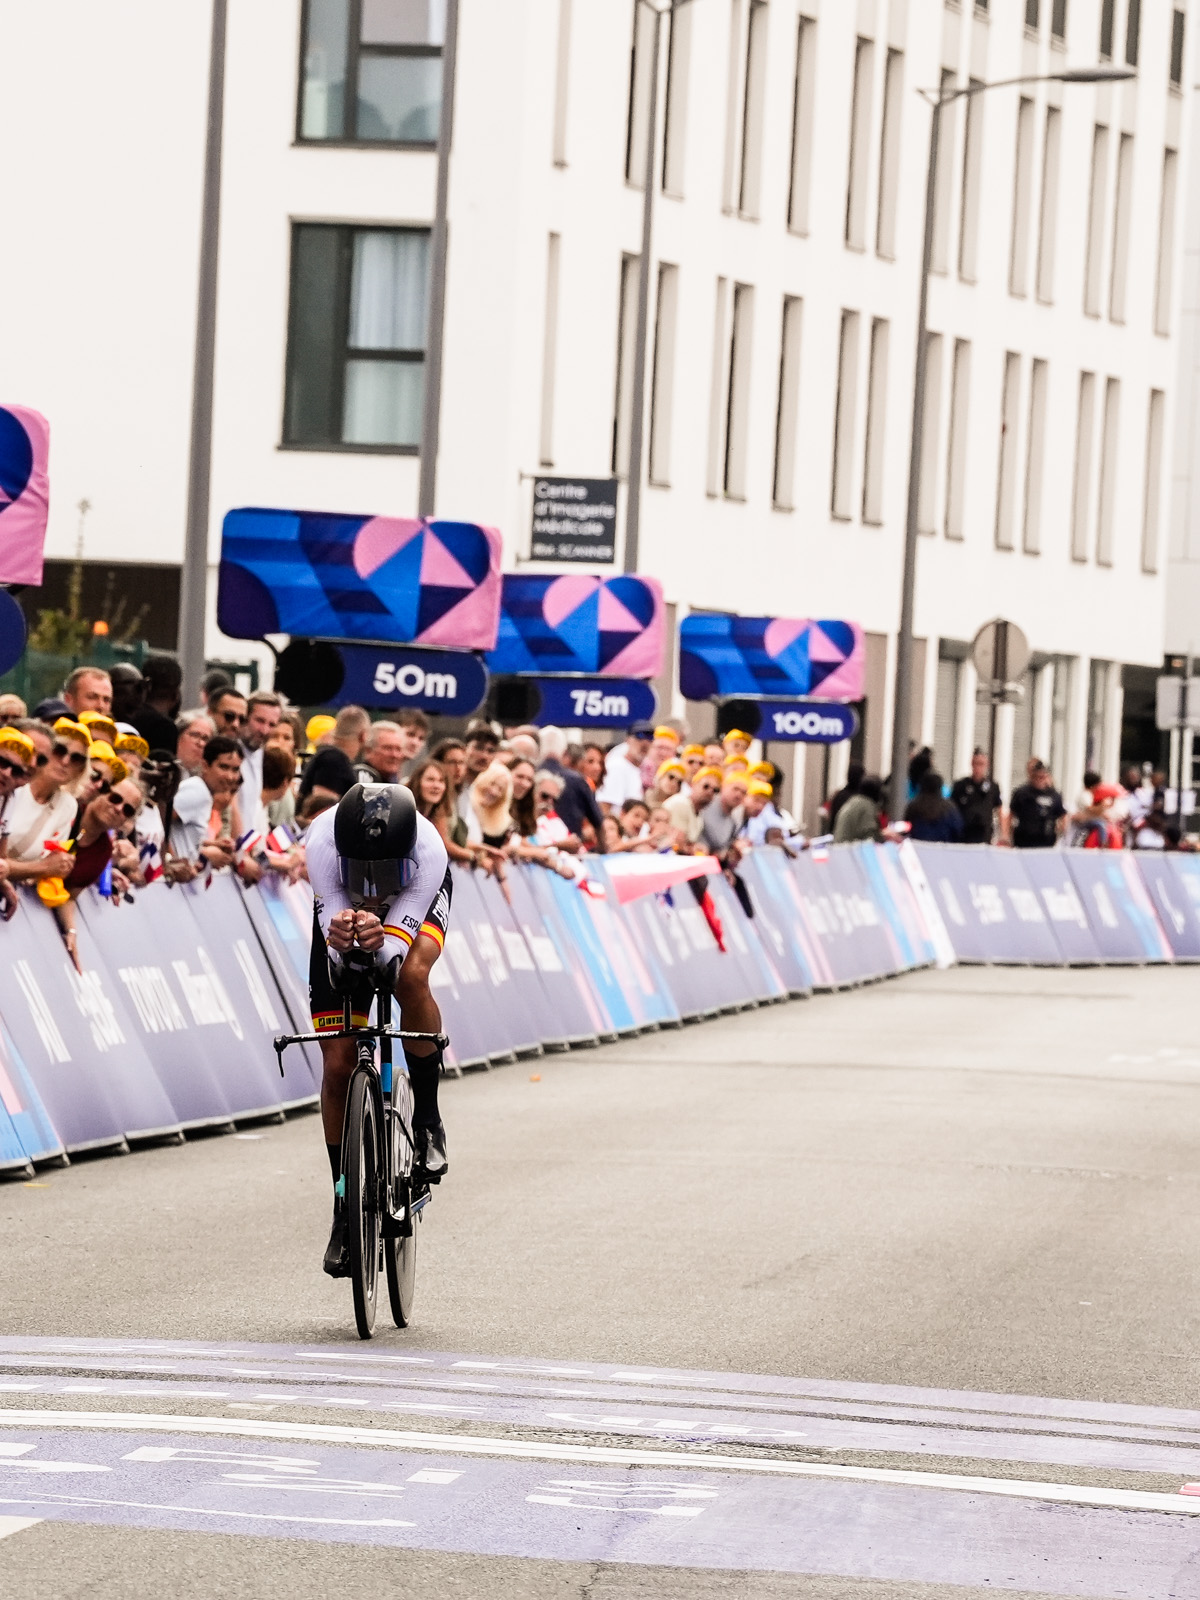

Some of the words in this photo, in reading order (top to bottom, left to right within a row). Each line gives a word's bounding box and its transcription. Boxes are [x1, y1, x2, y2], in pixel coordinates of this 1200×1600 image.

[535, 481, 588, 500] Centre
[373, 662, 457, 699] 50m
[571, 690, 630, 717] 75m
[772, 712, 843, 737] 100m
